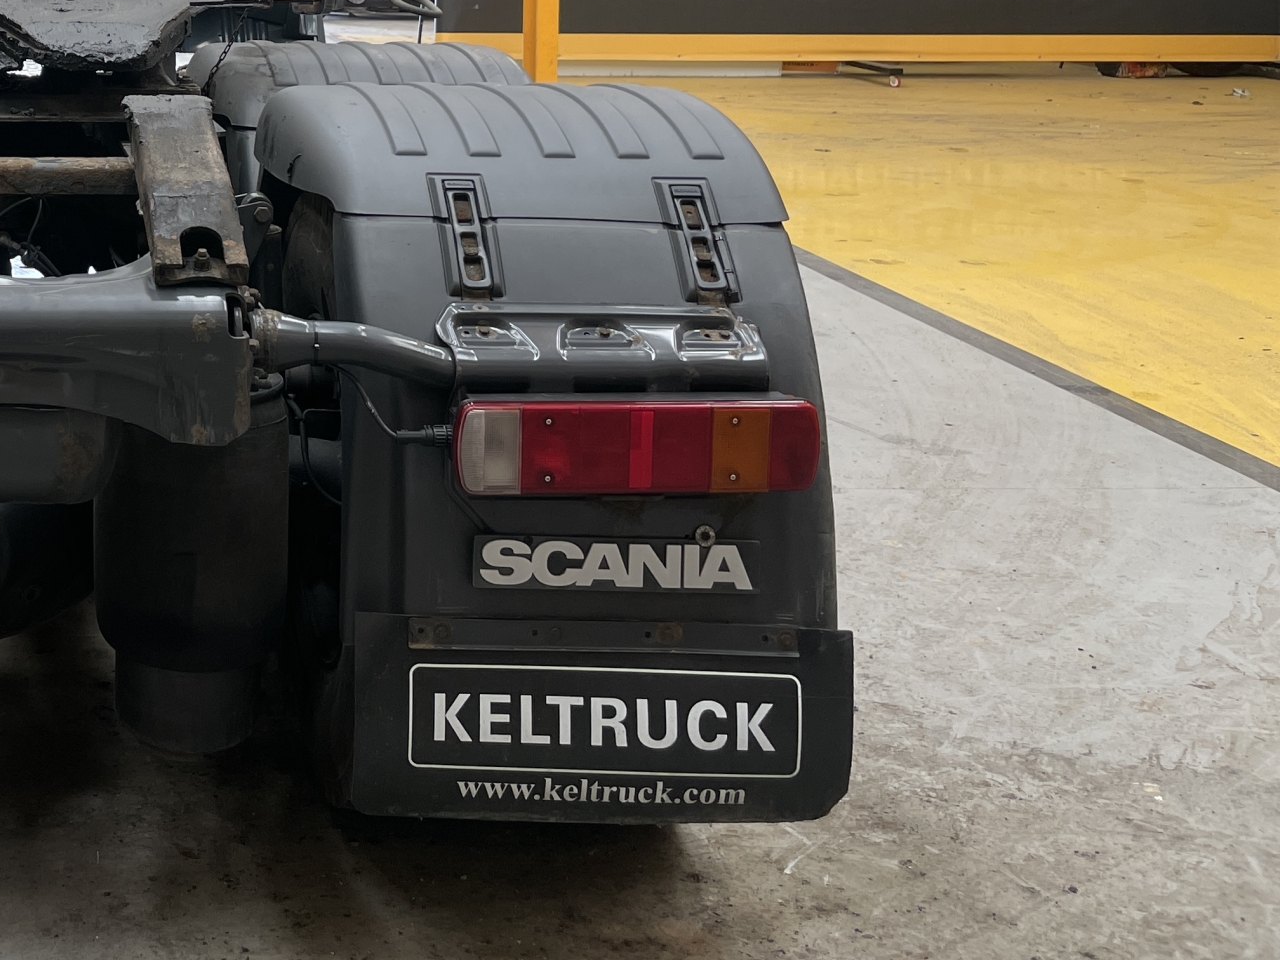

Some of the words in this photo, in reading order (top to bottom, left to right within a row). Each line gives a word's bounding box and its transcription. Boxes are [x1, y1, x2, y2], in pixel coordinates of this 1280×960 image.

[479, 540, 753, 590] SCANIA
[434, 693, 775, 751] KELTRUCK
[457, 778, 746, 805] www.keltruck.com
